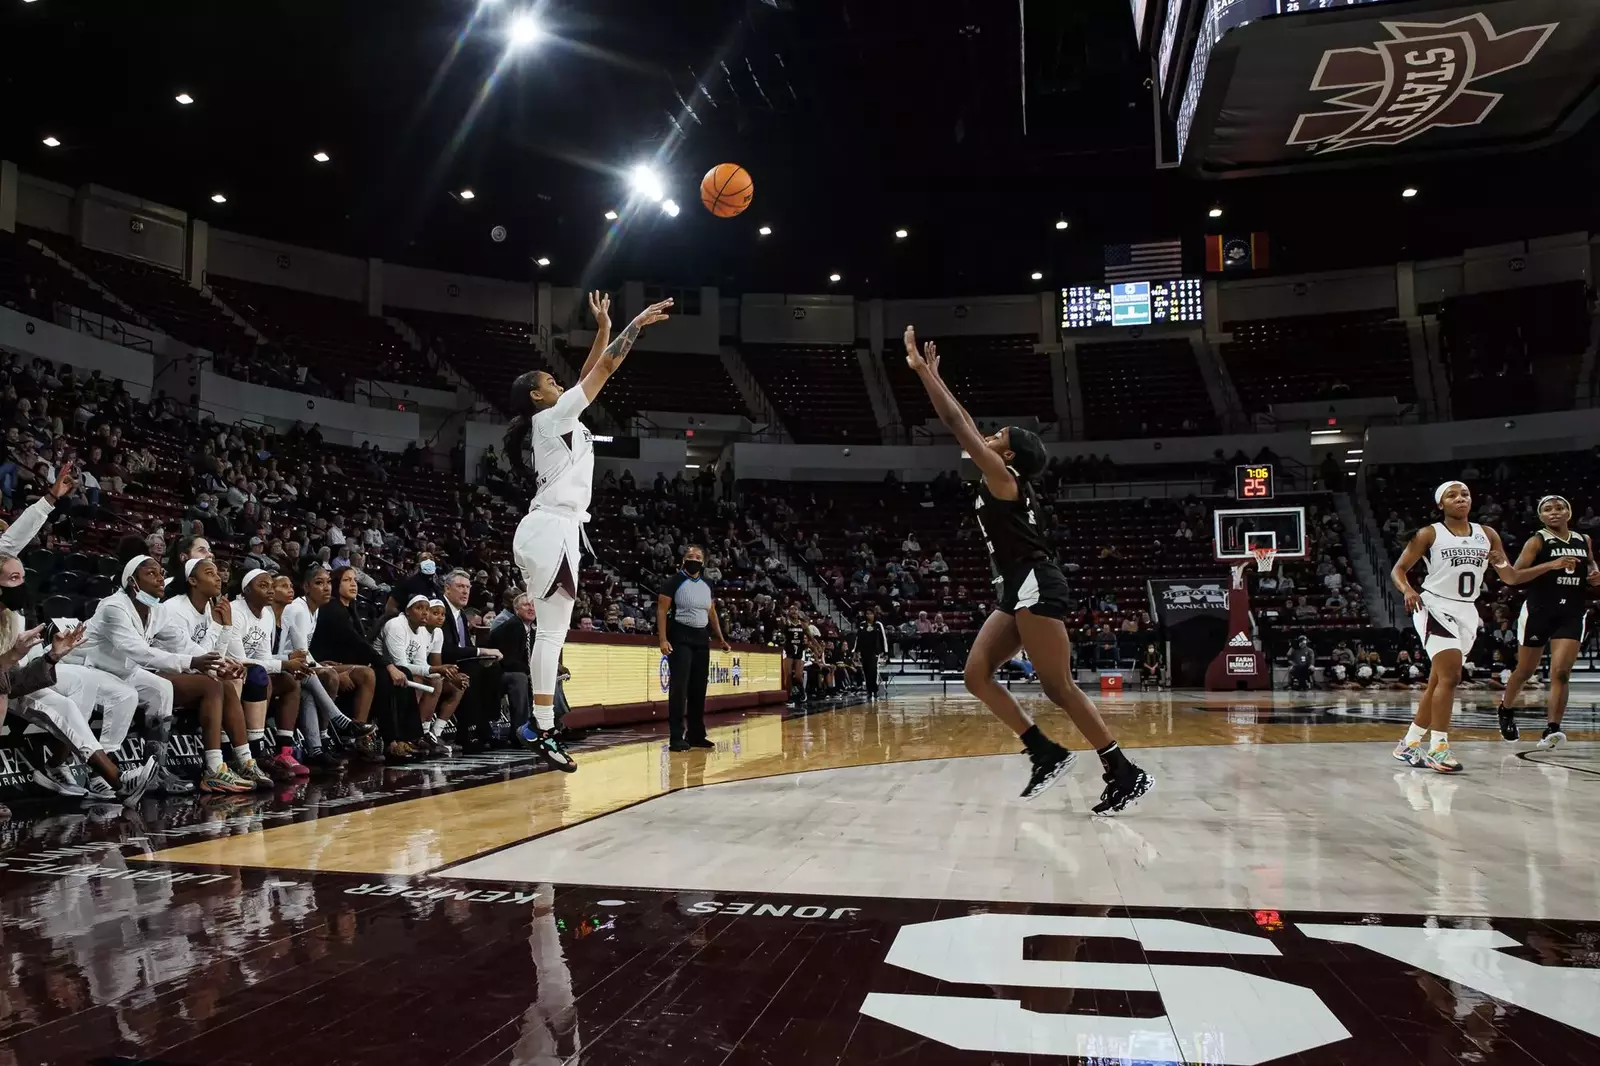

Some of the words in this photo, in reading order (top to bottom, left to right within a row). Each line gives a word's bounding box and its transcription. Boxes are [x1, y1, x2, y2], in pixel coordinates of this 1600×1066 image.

[1361, 47, 1455, 132] STATE
[1246, 467, 1268, 478] 7:06
[1244, 478, 1266, 496] 25
[1441, 549, 1488, 558] MISSISSI
[1550, 547, 1587, 557] ALABAMA
[1458, 571, 1476, 598] 0
[1556, 576, 1580, 586] STATE
[1166, 602, 1228, 610] BANKFIR
[343, 882, 542, 905] KEMPER
[687, 900, 863, 920] JONES
